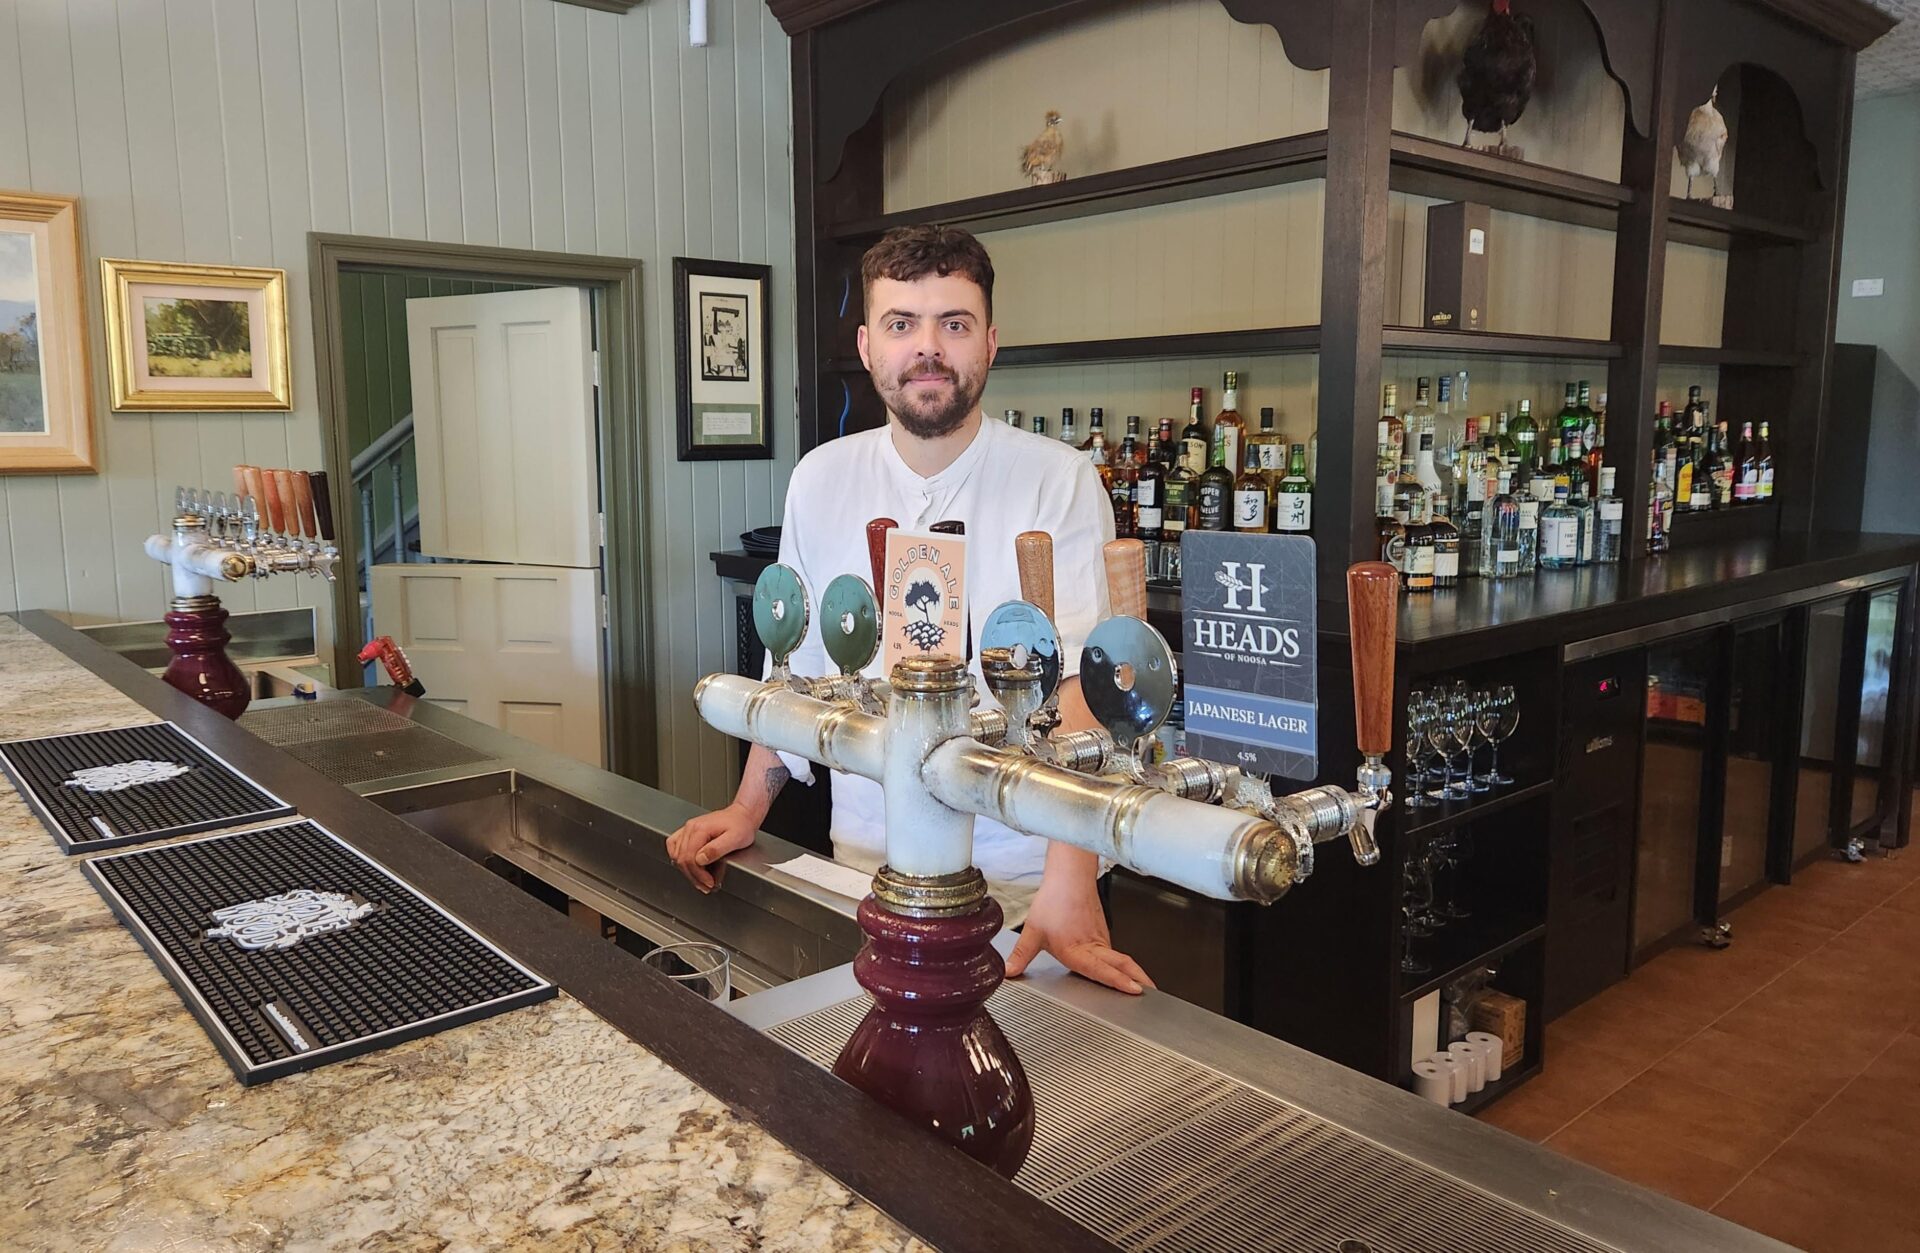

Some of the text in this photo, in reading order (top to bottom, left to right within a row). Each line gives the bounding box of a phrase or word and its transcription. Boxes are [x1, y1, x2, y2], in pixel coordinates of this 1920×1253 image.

[889, 544, 960, 610] GOLDEN ALE
[1193, 618, 1300, 659] HEADS
[1224, 652, 1267, 666] OF NOOSA
[1188, 700, 1308, 735] JAPANESE LAGER
[1237, 751, 1257, 763] 4.5%
